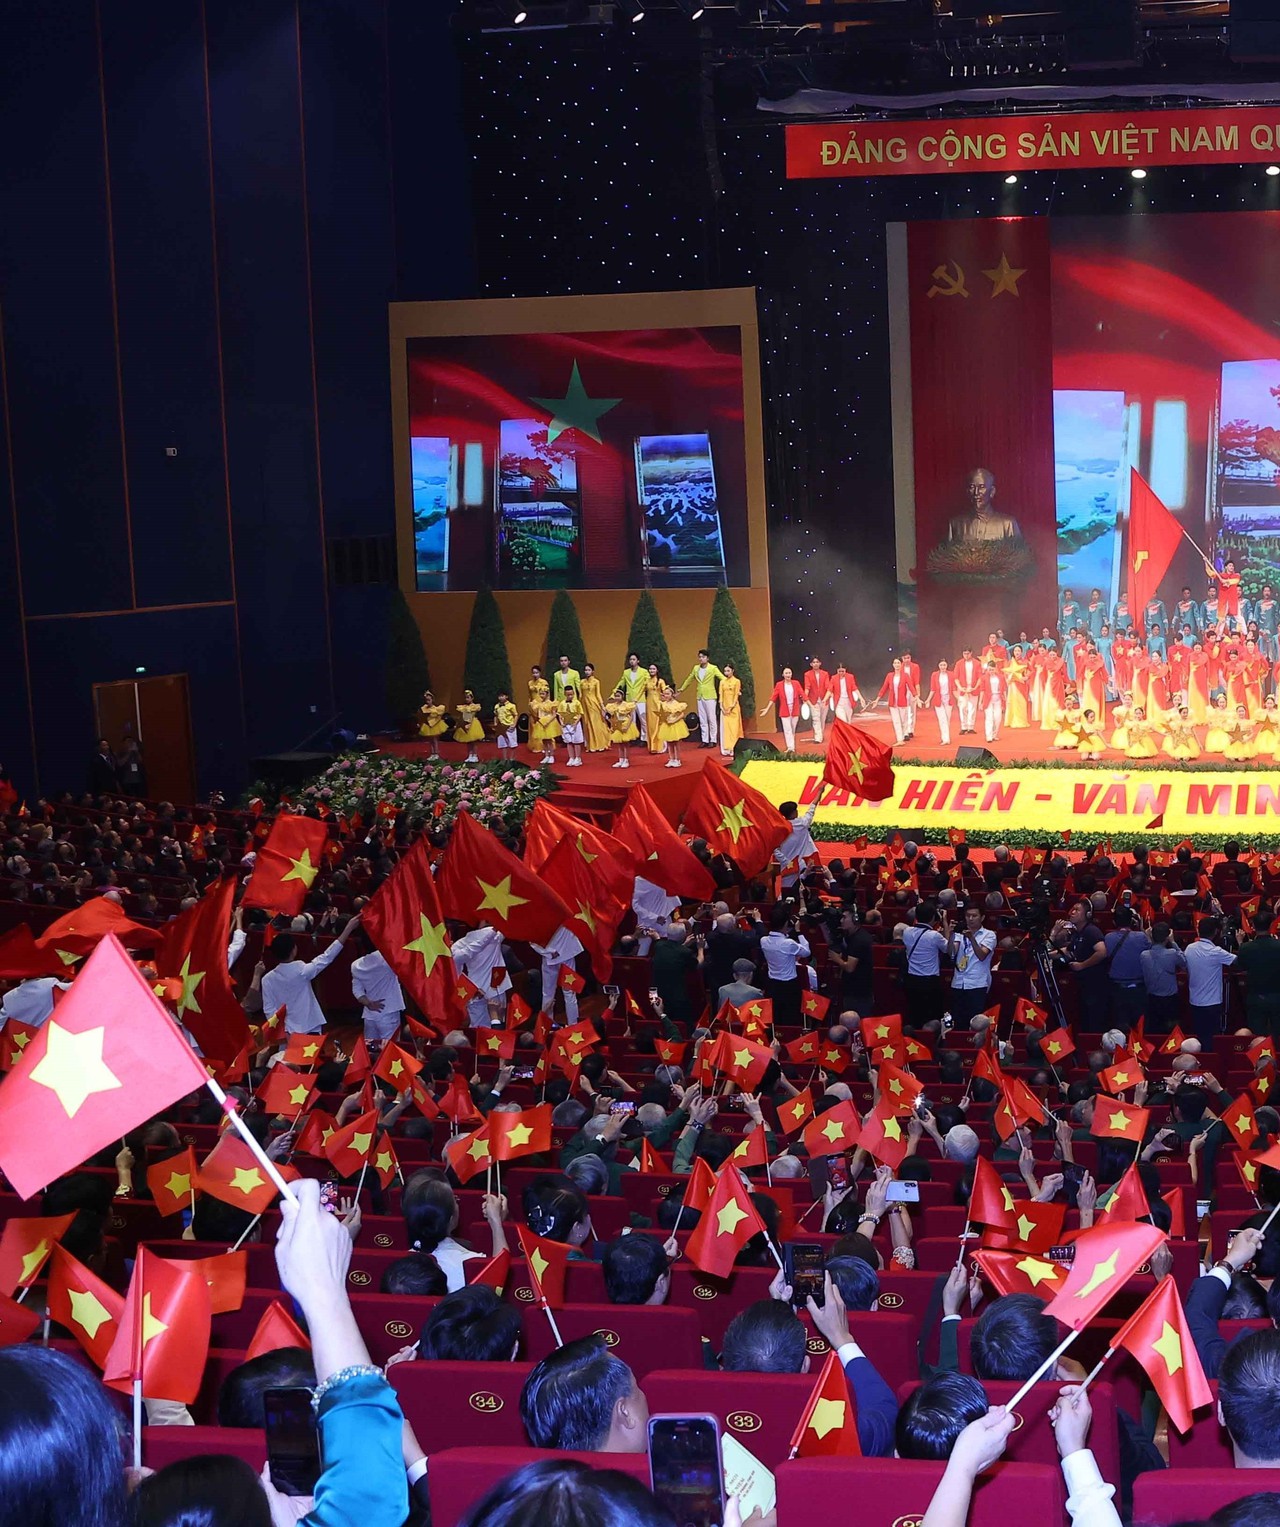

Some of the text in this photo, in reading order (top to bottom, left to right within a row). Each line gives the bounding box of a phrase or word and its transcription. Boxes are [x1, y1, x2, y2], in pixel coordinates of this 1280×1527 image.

[820, 130, 907, 166] ĐẢNG
[917, 129, 1007, 167] CỘNG
[1017, 122, 1080, 158] SẢN
[1090, 122, 1159, 161] VIỆT
[1170, 125, 1239, 153] NAM
[900, 769, 1020, 811] HIẾN
[1073, 774, 1171, 814] VĂN
[884, 1295, 897, 1305] 31
[391, 1324, 407, 1334] 35
[808, 1340, 825, 1349] 33
[475, 1397, 496, 1409] 34
[734, 1416, 753, 1427] 33
